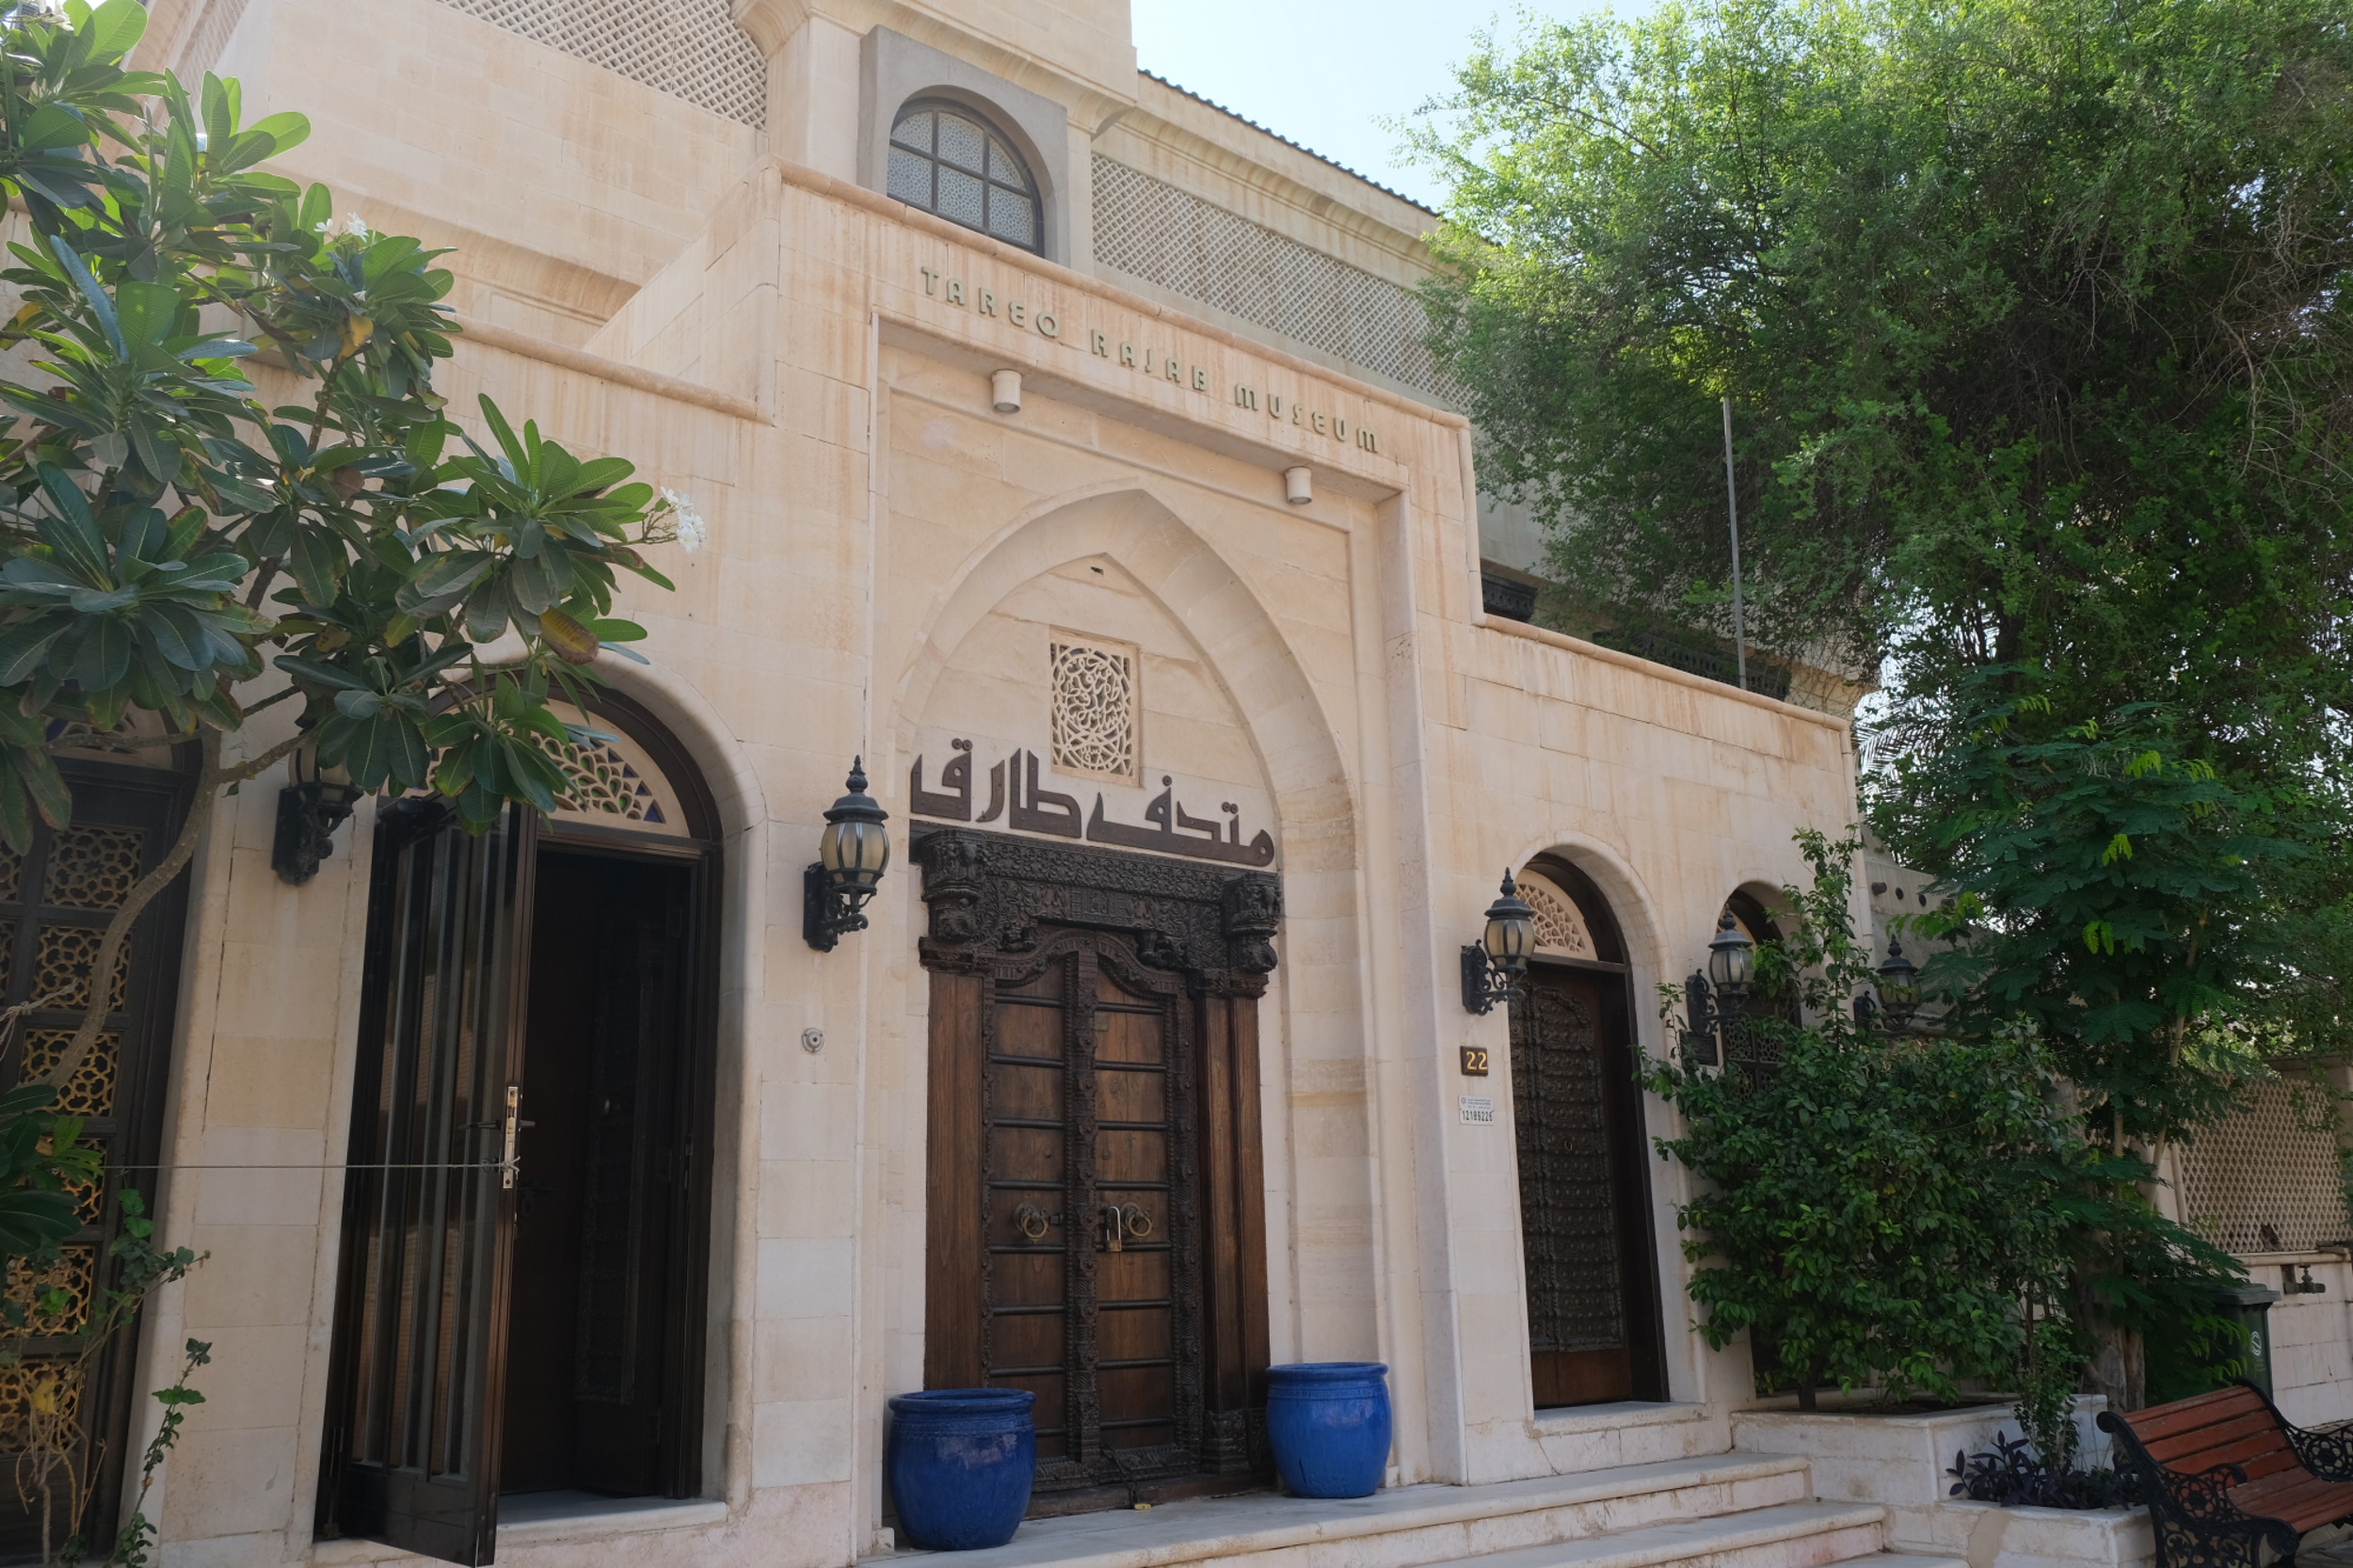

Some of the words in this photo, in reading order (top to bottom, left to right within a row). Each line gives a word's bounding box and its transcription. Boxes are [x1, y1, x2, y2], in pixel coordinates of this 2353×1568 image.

[920, 266, 1060, 338] TAREQ
[1091, 329, 1209, 391] RAJAB
[1235, 382, 1379, 454] MUSEUM
[910, 737, 1082, 840] طارق
[1086, 775, 1274, 868] متحف
[1465, 1050, 1488, 1070] 22
